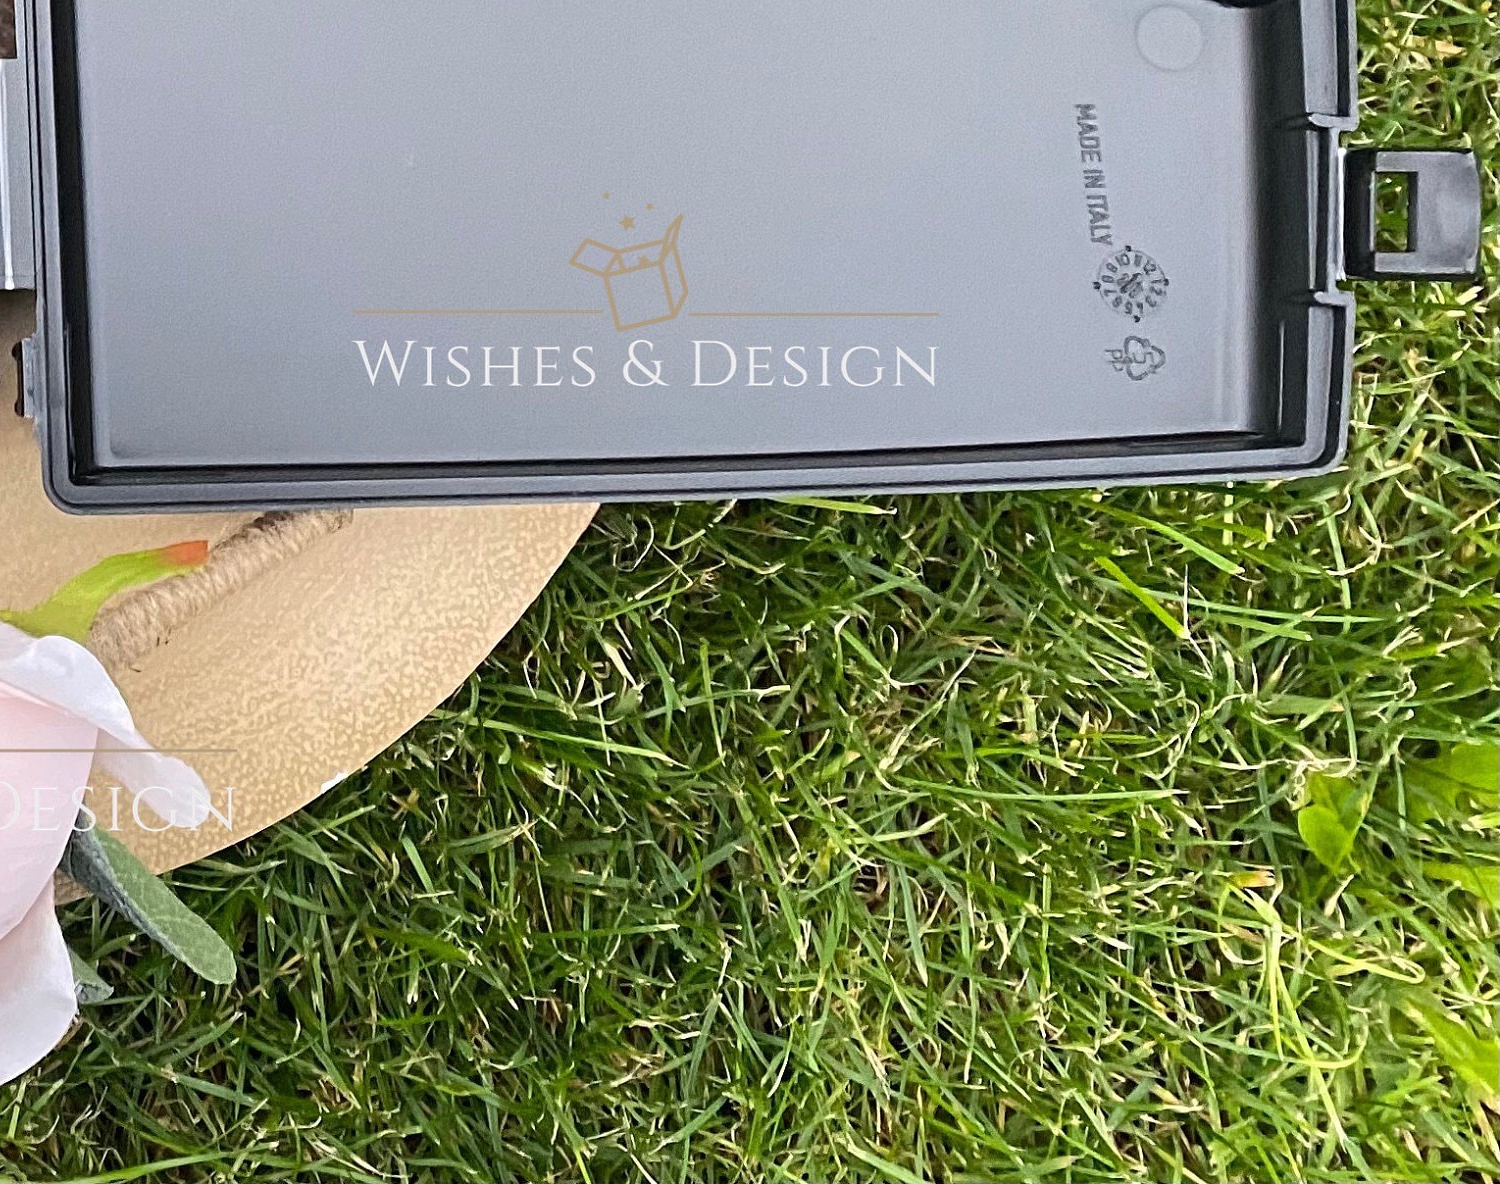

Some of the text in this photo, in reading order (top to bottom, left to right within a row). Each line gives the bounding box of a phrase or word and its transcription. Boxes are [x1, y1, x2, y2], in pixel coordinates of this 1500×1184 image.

[1075, 103, 1112, 245] MADE IN ITALY
